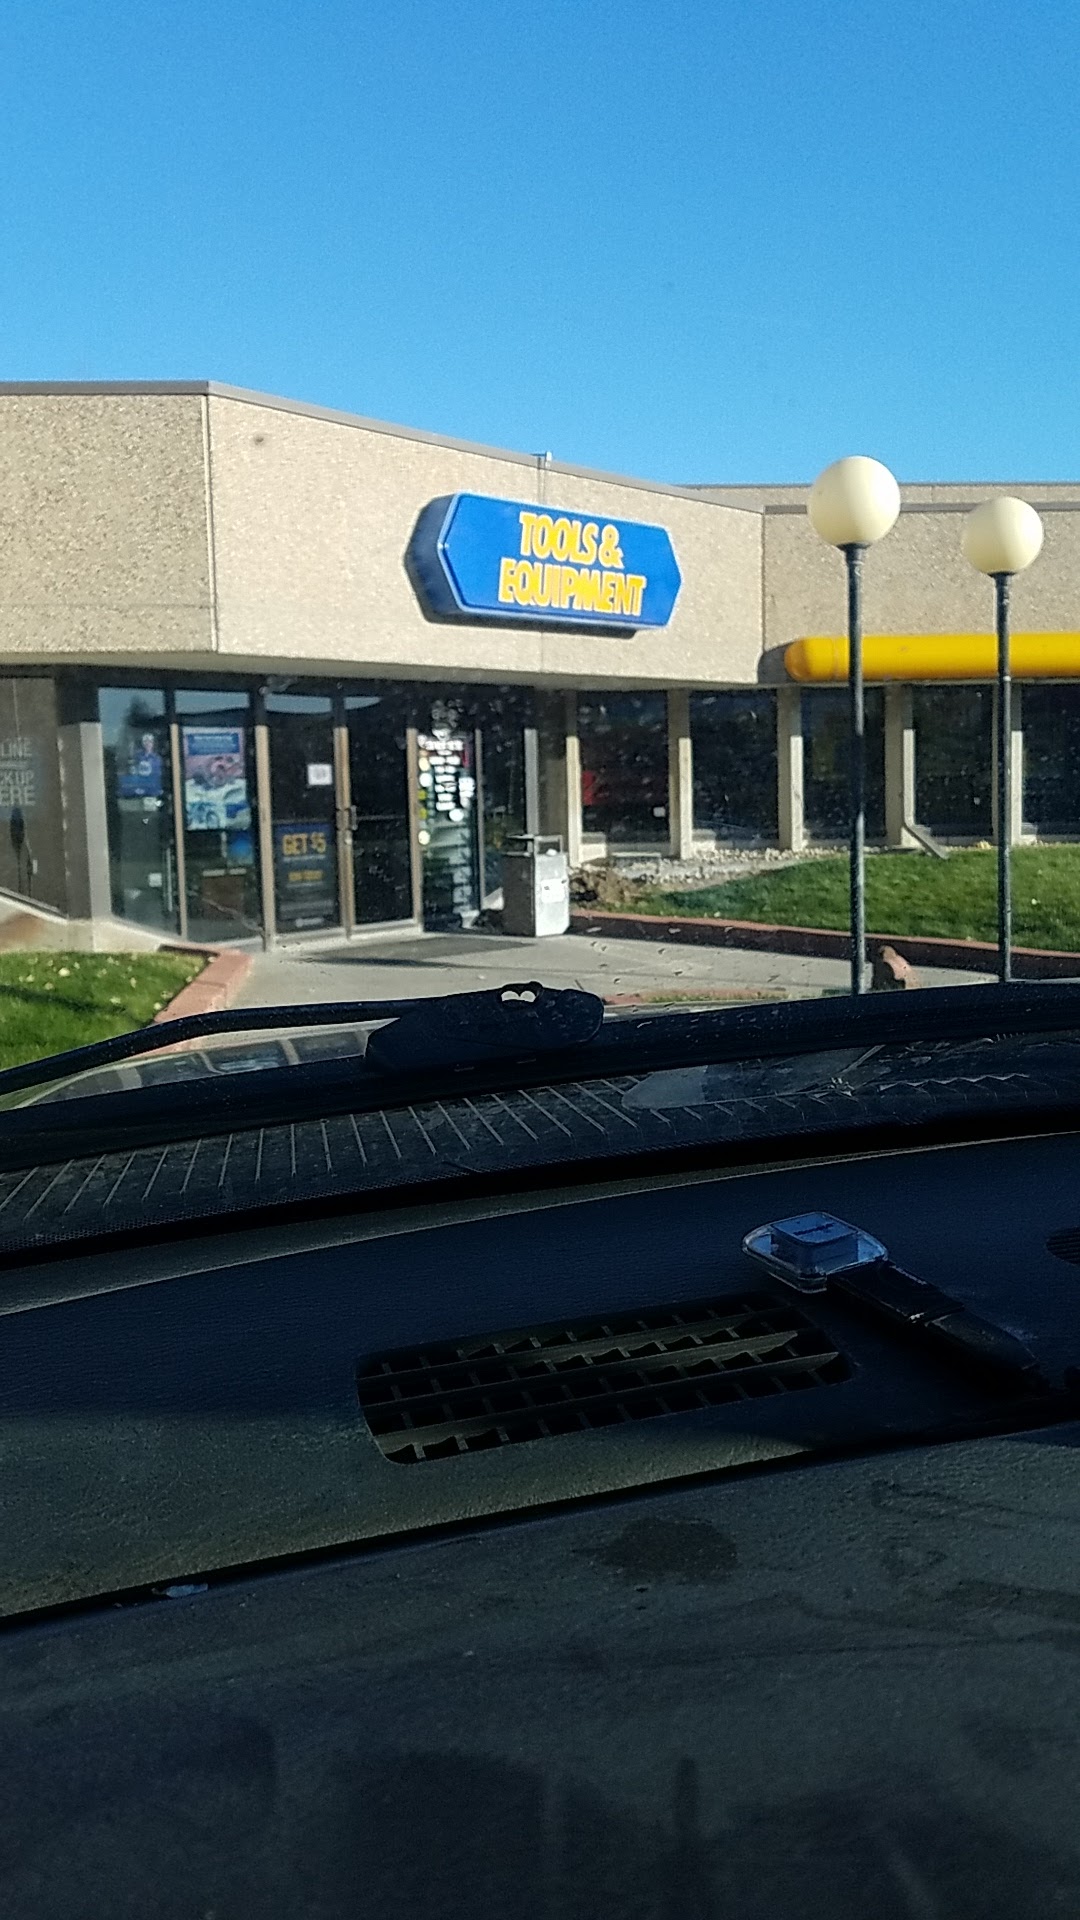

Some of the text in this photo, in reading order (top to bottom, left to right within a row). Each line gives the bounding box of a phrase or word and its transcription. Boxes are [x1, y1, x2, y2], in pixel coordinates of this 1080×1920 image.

[519, 511, 625, 569] TOOLS &
[498, 557, 647, 617] EQUIPMENT
